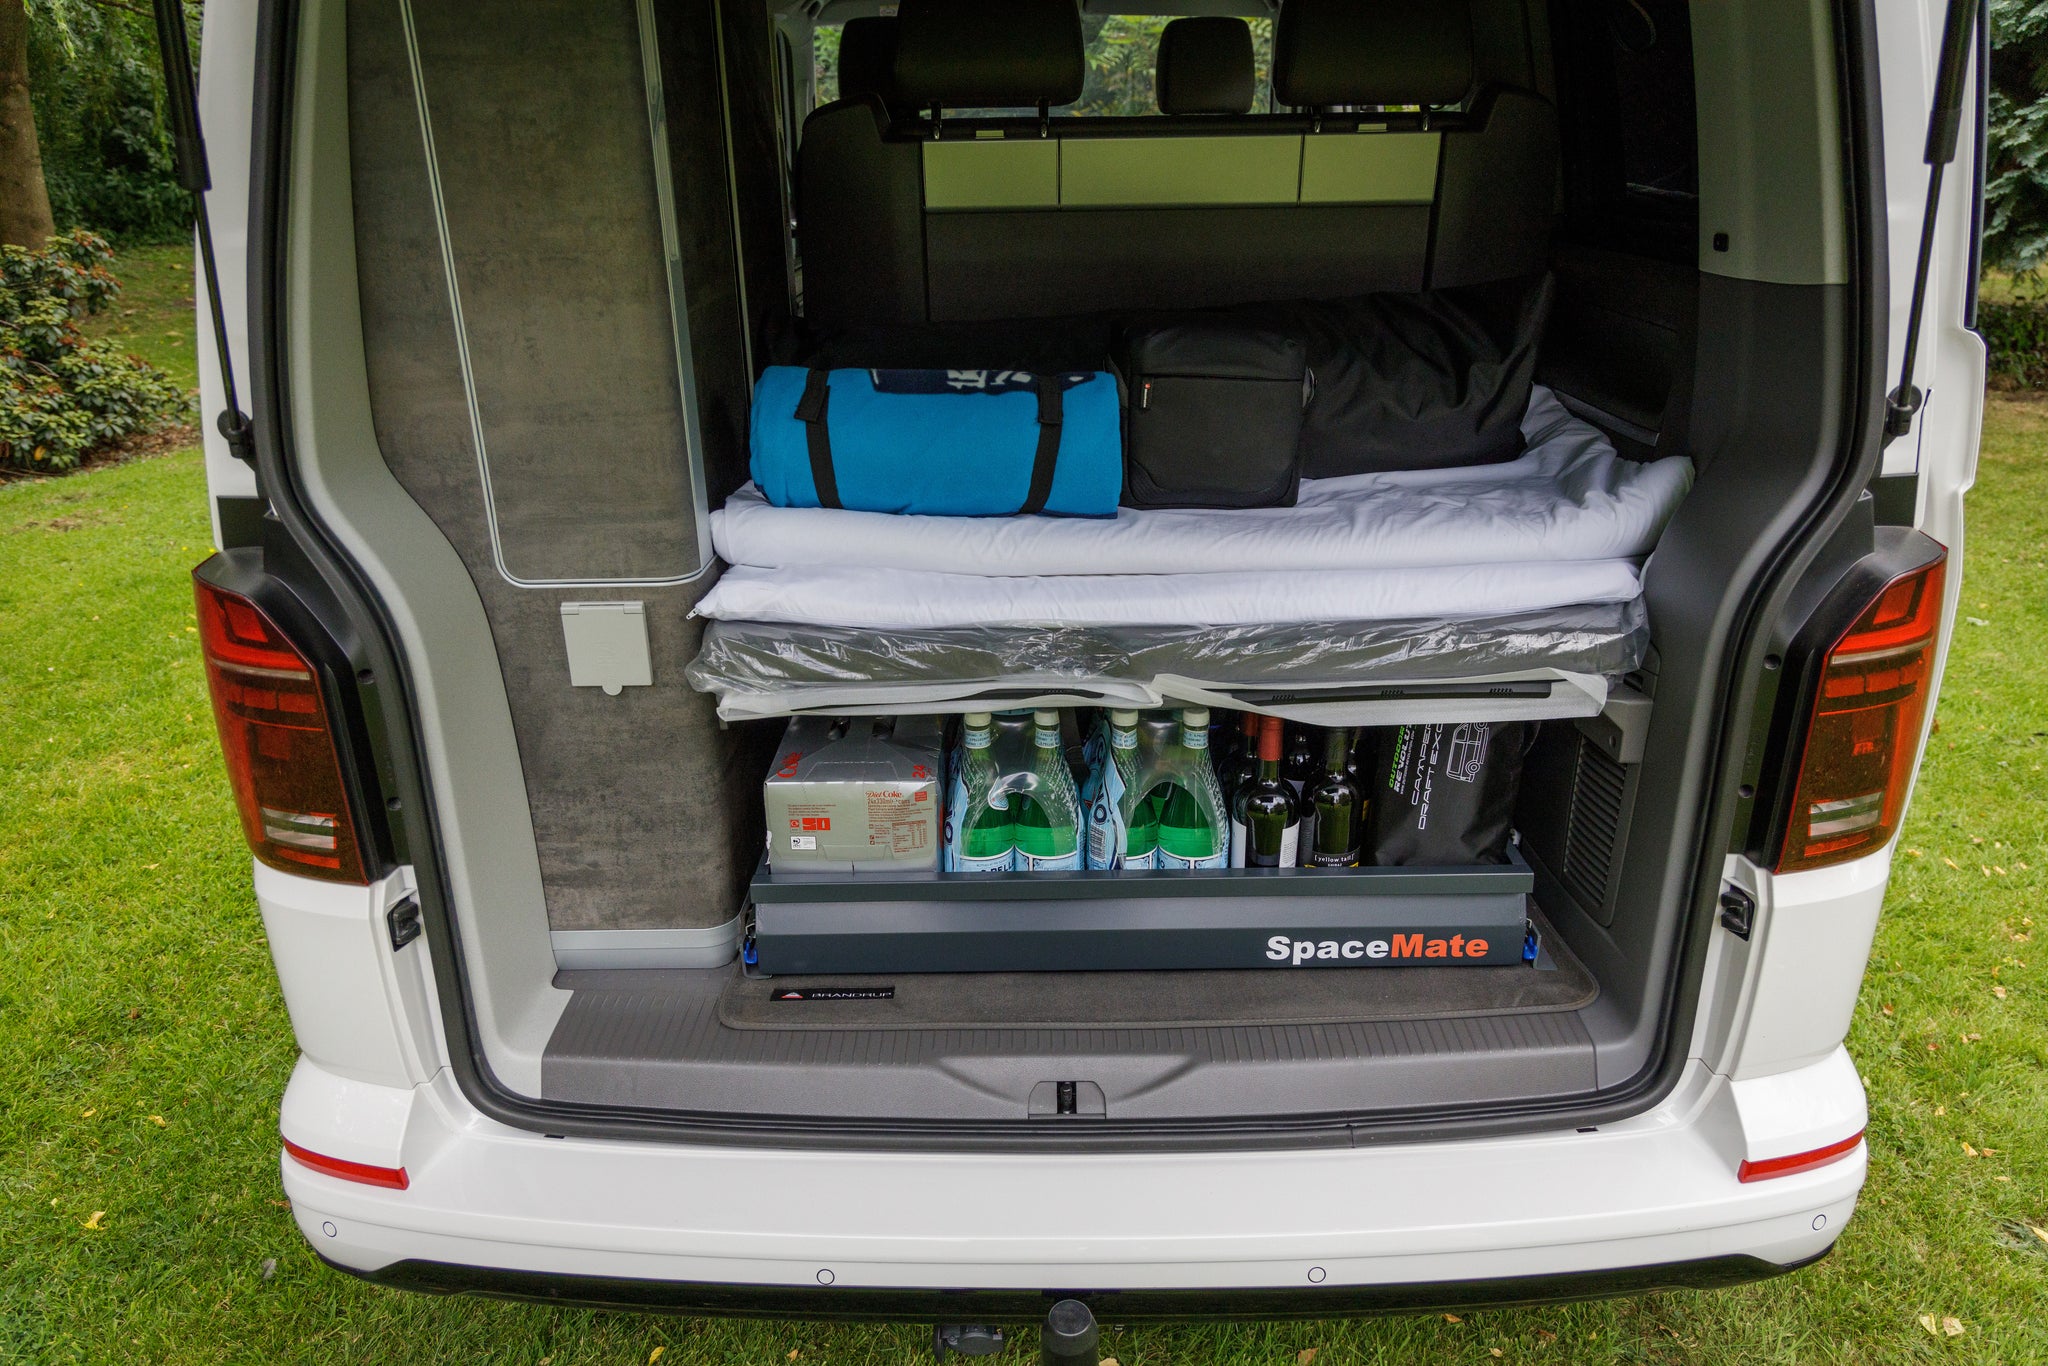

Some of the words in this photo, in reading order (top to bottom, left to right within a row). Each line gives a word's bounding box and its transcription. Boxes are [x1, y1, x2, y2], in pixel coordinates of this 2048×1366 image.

[912, 764, 925, 779] 24
[1389, 726, 1405, 788] OUTDOOR
[883, 790, 902, 798] Coke
[1418, 766, 1435, 830] DRAFT
[1266, 933, 1489, 965] SpaceMate
